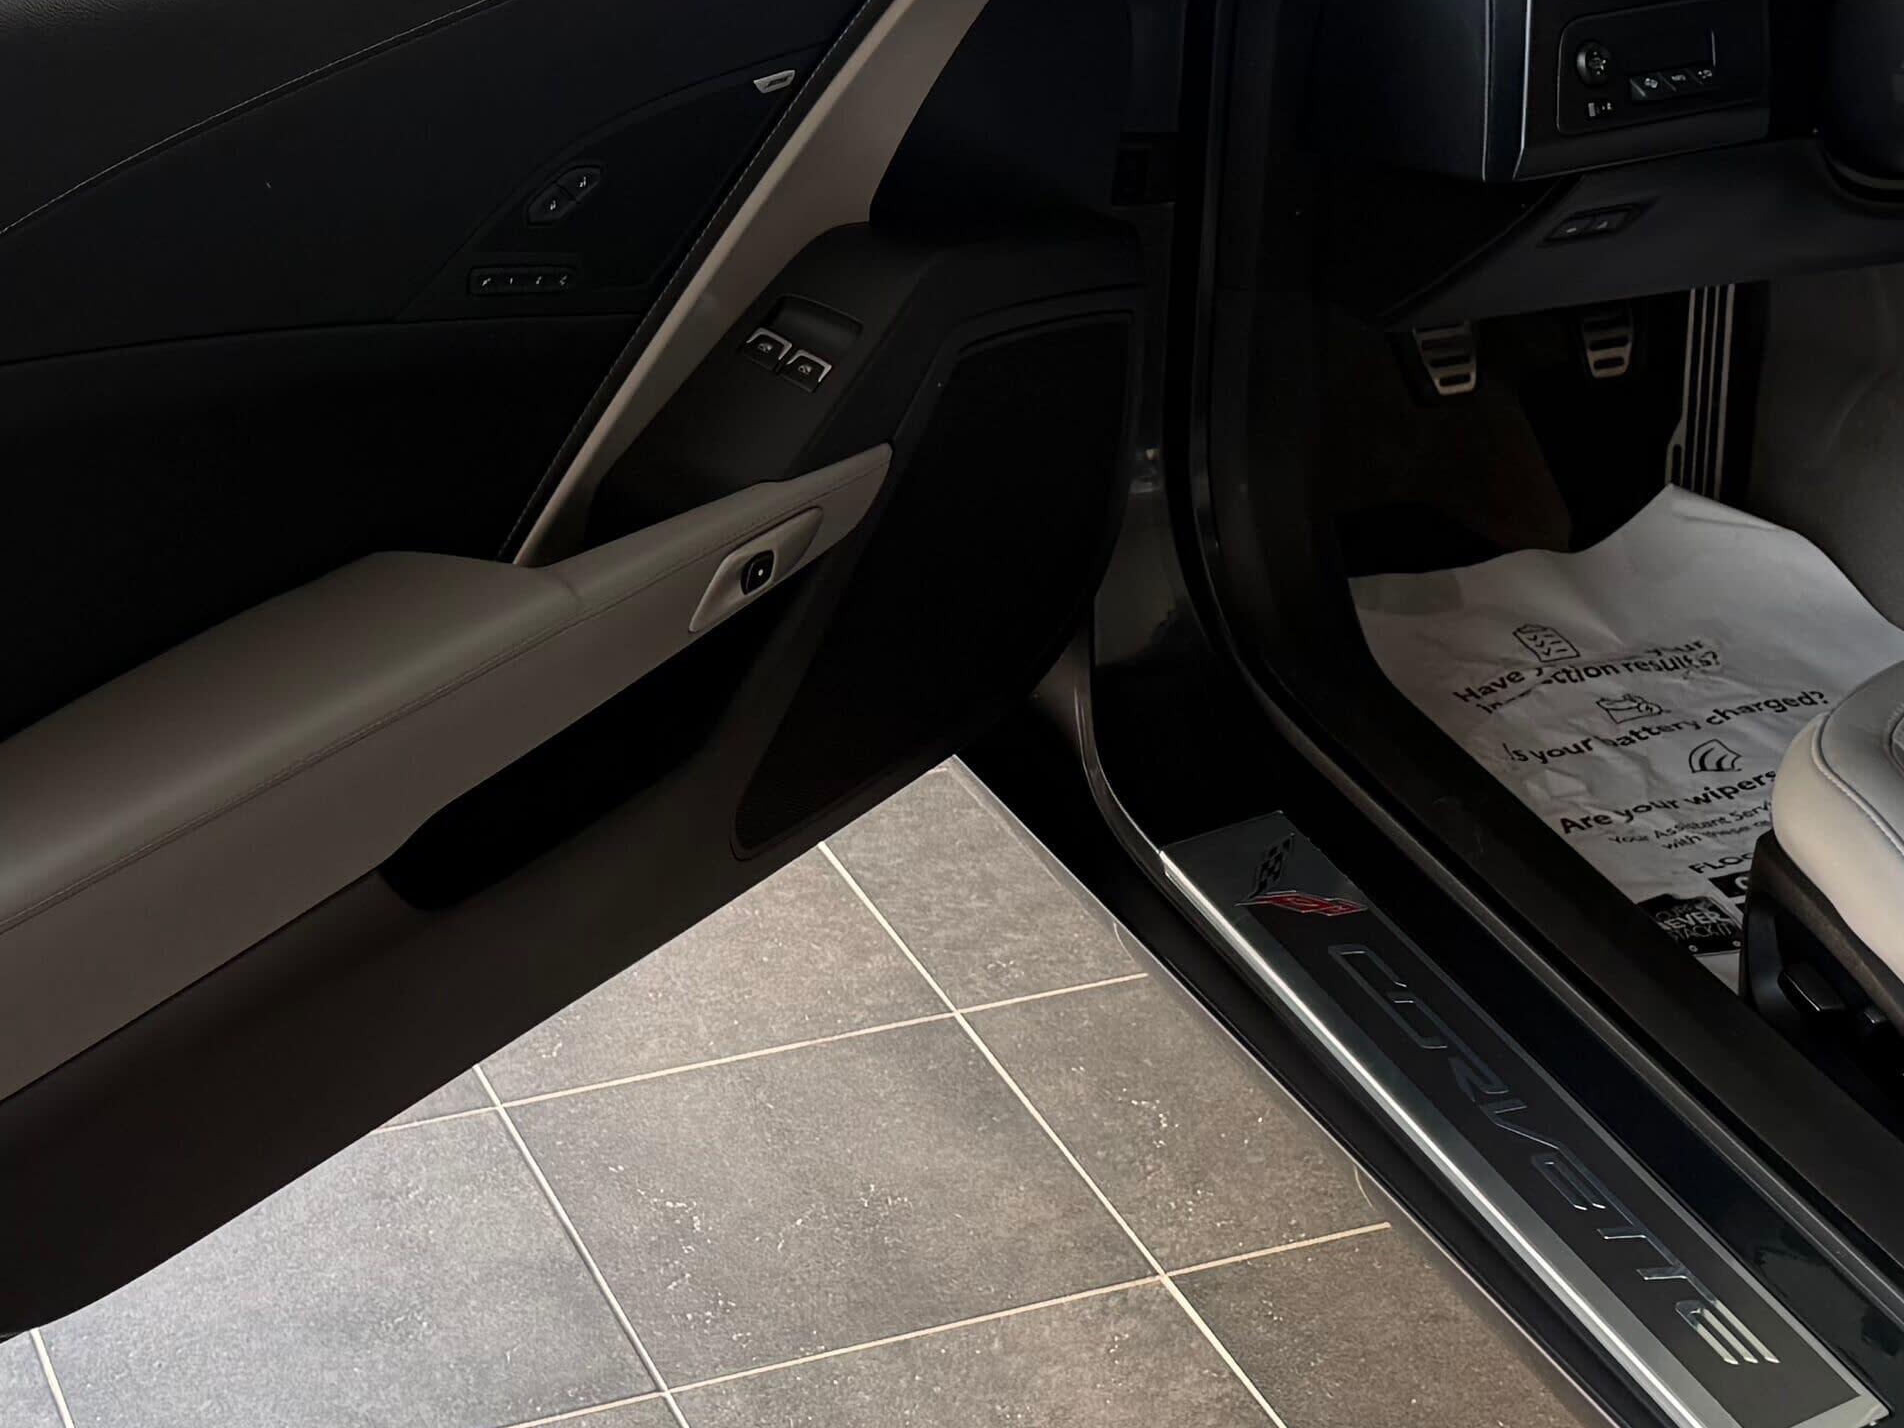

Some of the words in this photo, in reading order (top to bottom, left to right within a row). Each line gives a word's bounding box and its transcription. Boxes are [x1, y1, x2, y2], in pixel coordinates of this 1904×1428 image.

[1452, 670, 1526, 703] Have
[1528, 737, 1594, 764] your
[1705, 690, 1829, 727] charged?
[1558, 813, 1614, 837] Are
[1615, 798, 1682, 827] your
[1684, 769, 1776, 808] wipers
[1661, 834, 1703, 851] with
[1327, 943, 1782, 1367] CORVETTE
